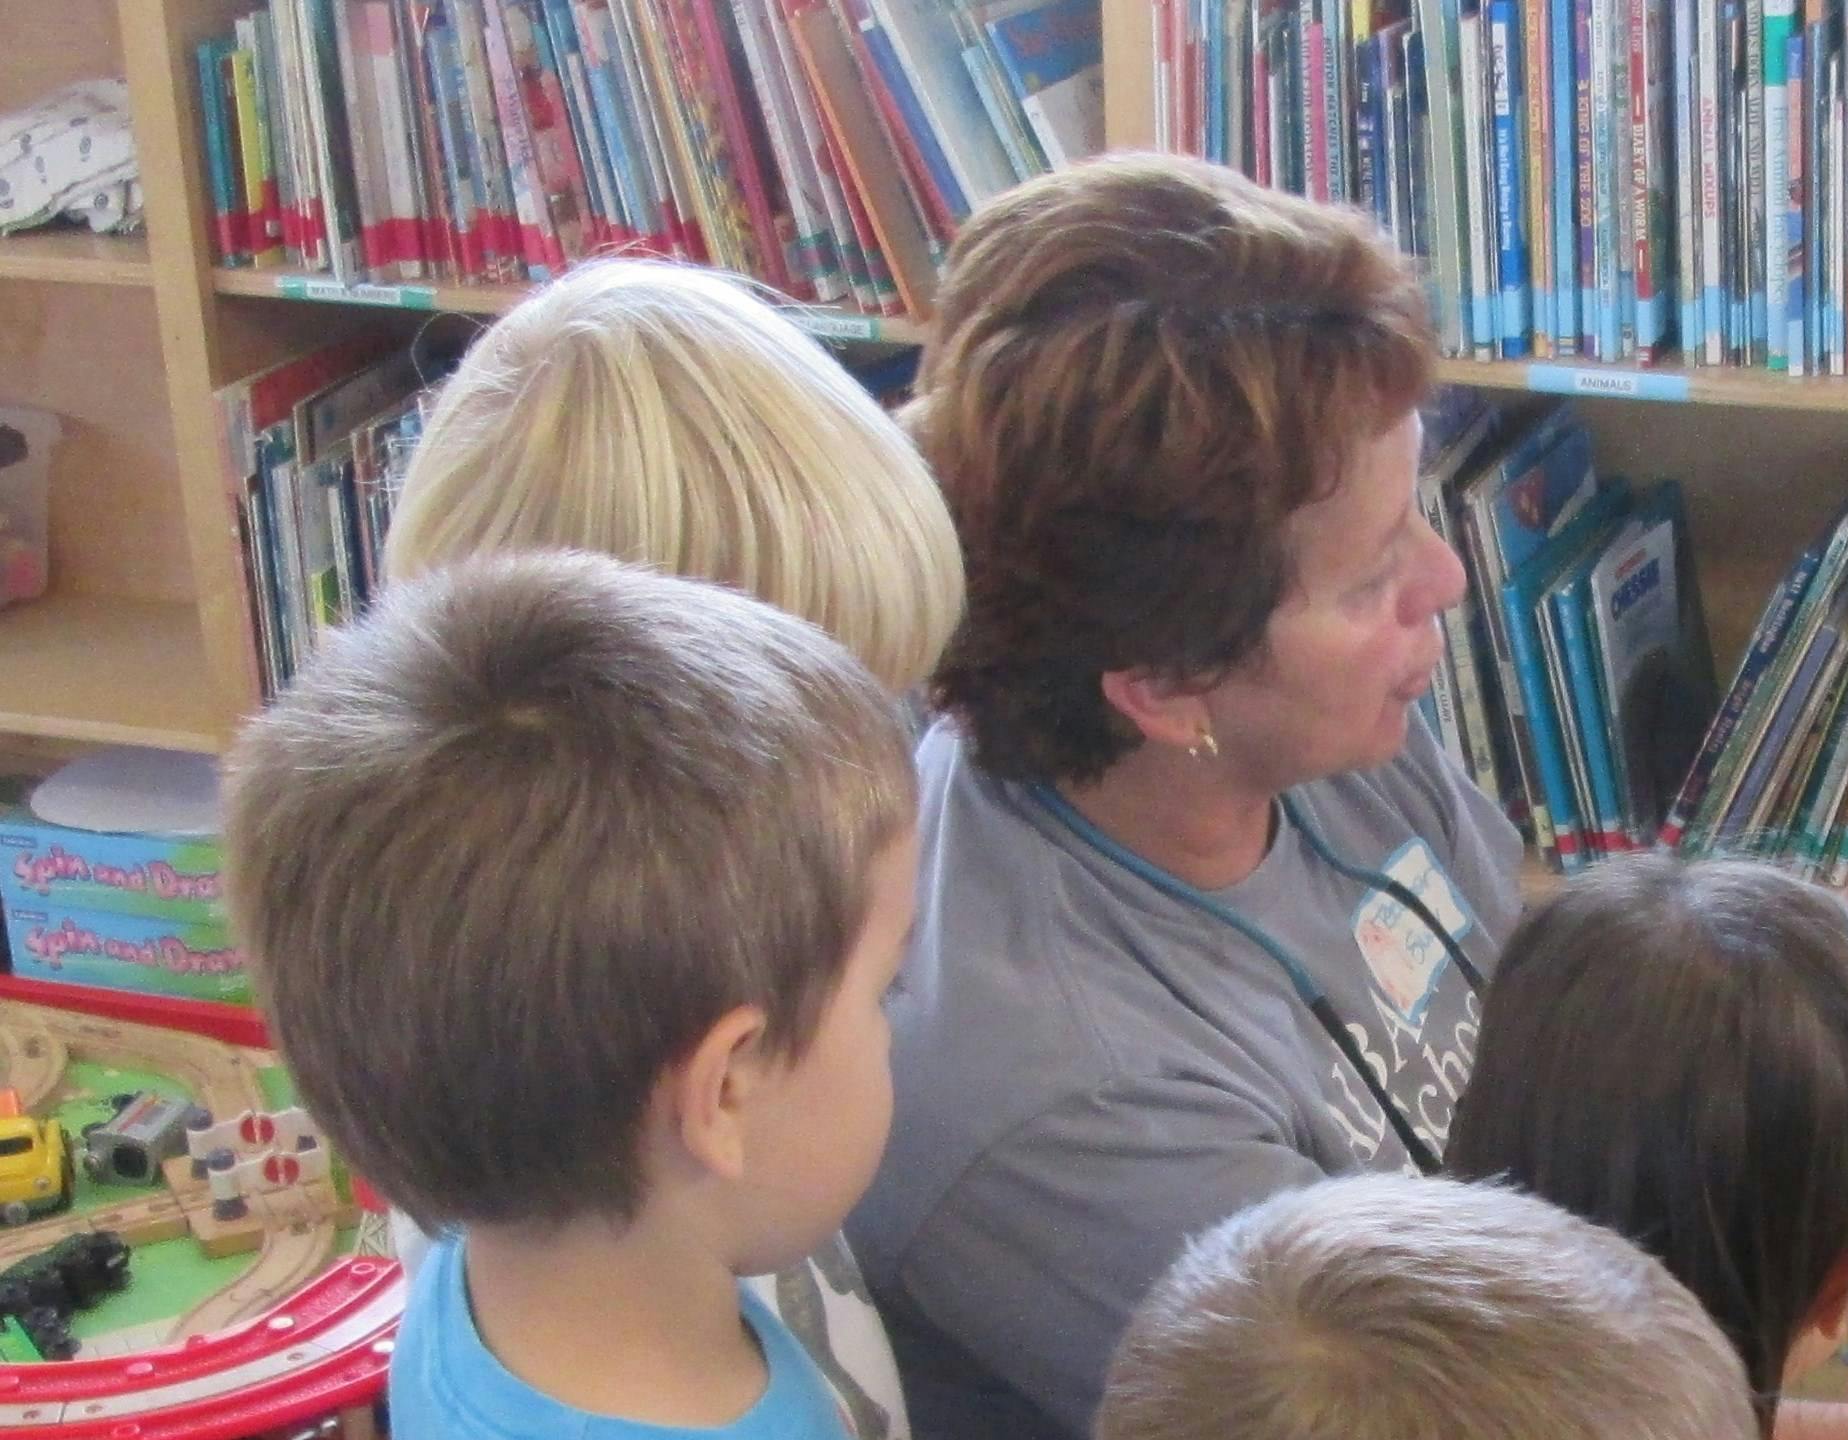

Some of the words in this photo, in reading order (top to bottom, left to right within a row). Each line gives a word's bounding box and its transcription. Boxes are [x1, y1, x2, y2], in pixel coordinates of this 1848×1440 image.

[1633, 124, 1645, 165] DIARY
[1702, 97, 1715, 153] ANIMAL
[1634, 169, 1646, 185] OF
[1704, 163, 1717, 219] MIXUPS
[1635, 199, 1648, 240] WORM
[1580, 378, 1635, 393] ANIMALS
